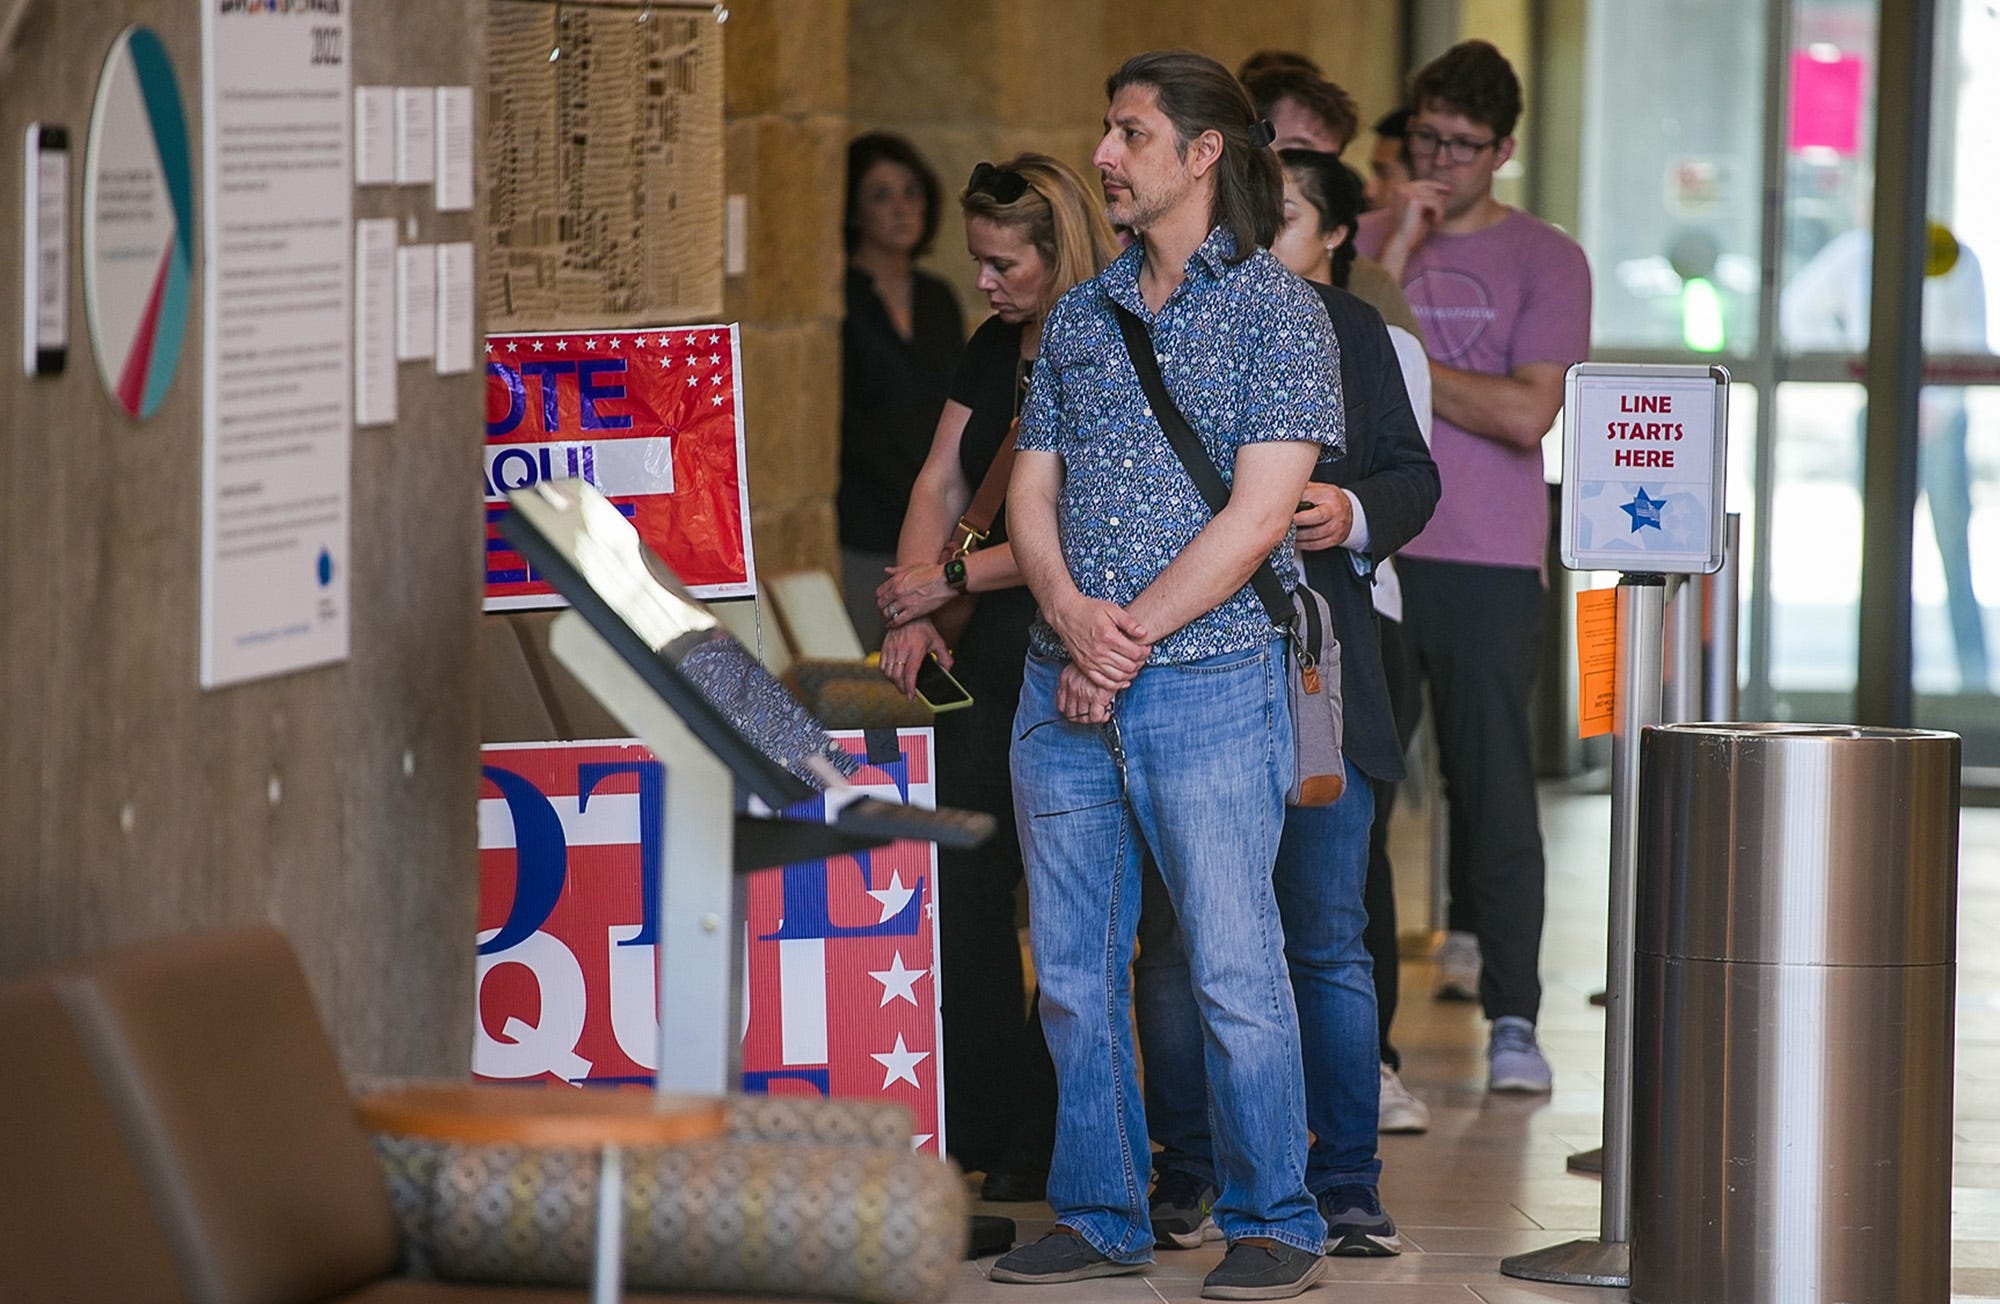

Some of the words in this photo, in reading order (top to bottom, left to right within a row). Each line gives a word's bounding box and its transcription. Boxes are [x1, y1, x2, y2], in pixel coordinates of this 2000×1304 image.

[486, 358, 634, 436] OTE
[1621, 395, 1672, 414] LINE
[1607, 422, 1684, 441] STARTS
[1615, 449, 1675, 468] HERE
[485, 446, 595, 497] QUI
